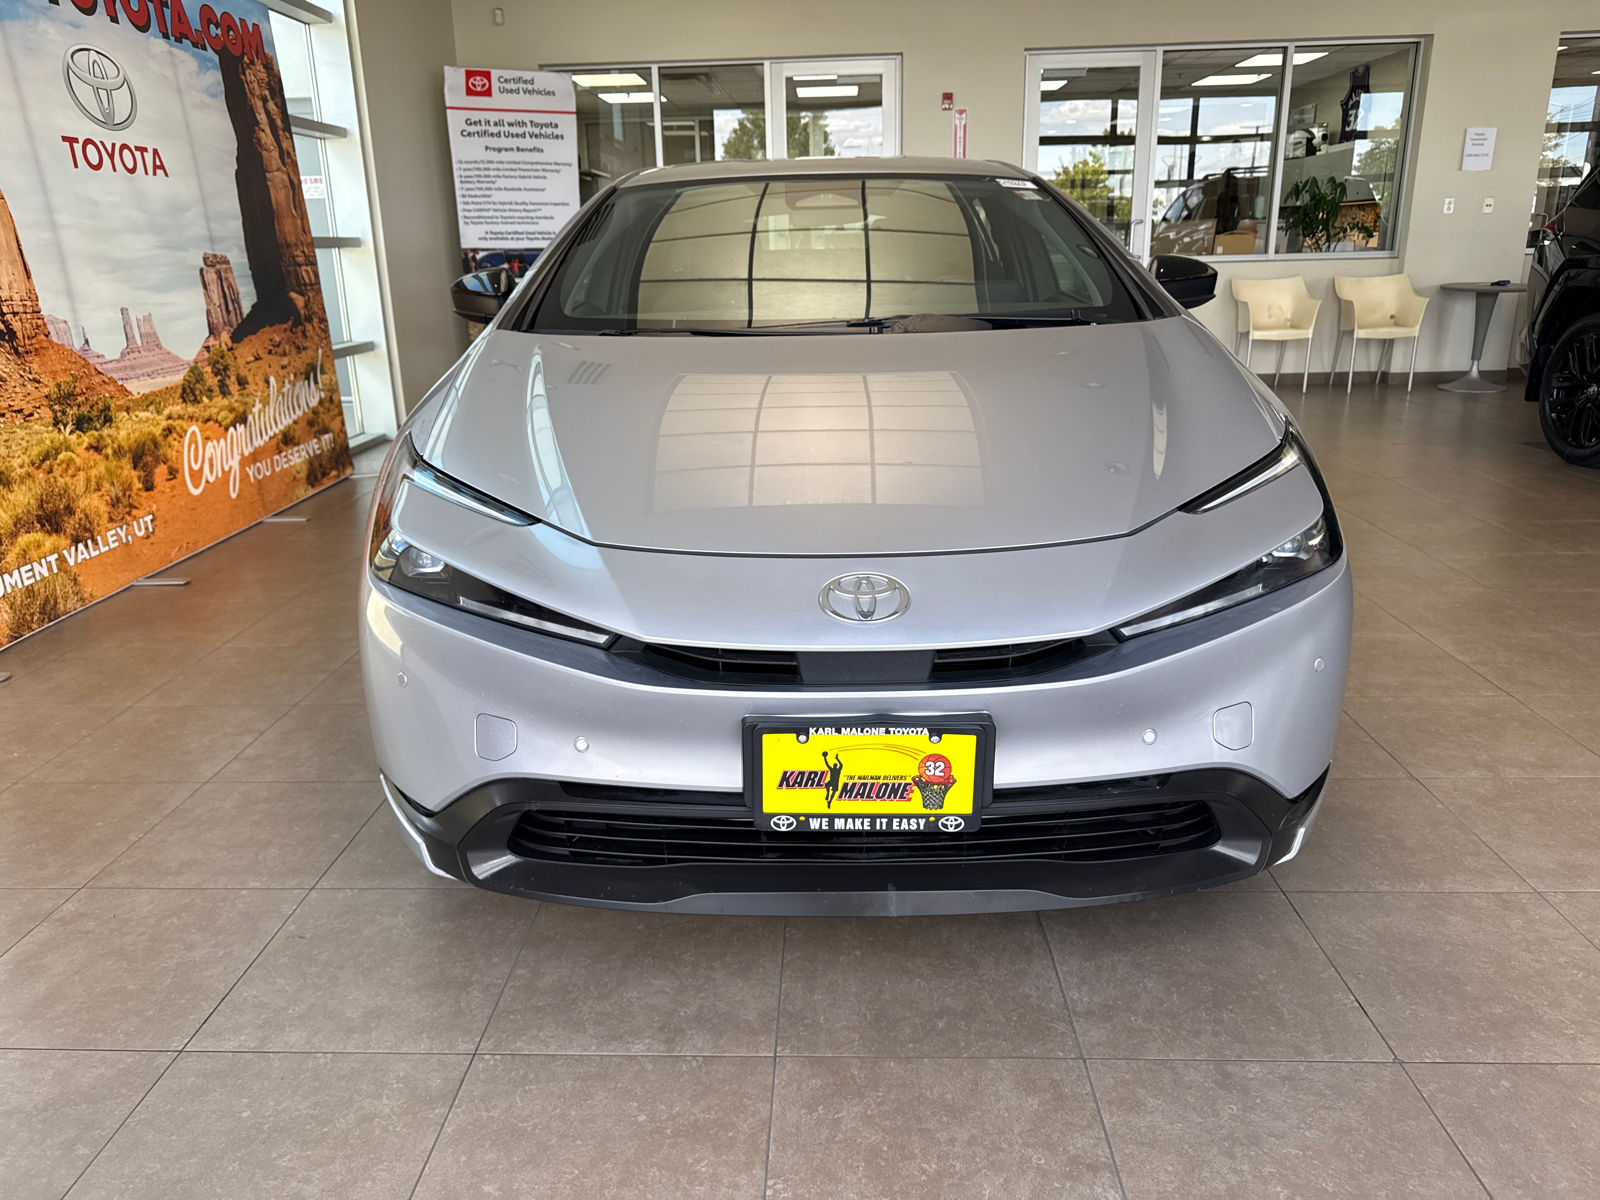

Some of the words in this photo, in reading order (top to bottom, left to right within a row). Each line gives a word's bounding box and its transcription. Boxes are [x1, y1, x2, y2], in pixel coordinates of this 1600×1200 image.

[50, 0, 268, 65] OTA.COM
[498, 76, 534, 85] Certified
[498, 86, 520, 95] Used
[522, 87, 556, 97] Vehicles
[465, 118, 482, 127] Get
[484, 118, 492, 127] it
[494, 119, 505, 128] all
[507, 120, 527, 128] with
[529, 120, 558, 131] Toyota
[460, 129, 500, 138] Certified
[503, 130, 526, 139] Used
[528, 132, 564, 140] Vehicles
[61, 135, 169, 178] TOYOTA
[485, 146, 514, 154] Program
[184, 347, 325, 499] Congratulations!
[246, 458, 272, 483] YOU
[273, 438, 321, 472] DESERVE
[320, 432, 334, 451] IT!
[62, 524, 132, 567] VALLEY,
[132, 514, 154, 537] UT
[809, 727, 839, 736] KARL
[841, 727, 886, 736] MALONE
[888, 728, 929, 736] TOYOTA
[925, 761, 945, 777] 32
[777, 770, 828, 789] KARL
[836, 782, 914, 801] MALONE
[809, 818, 829, 830] WE
[834, 818, 871, 830] MAKE
[876, 818, 888, 830] IT
[892, 818, 926, 830] EASY
